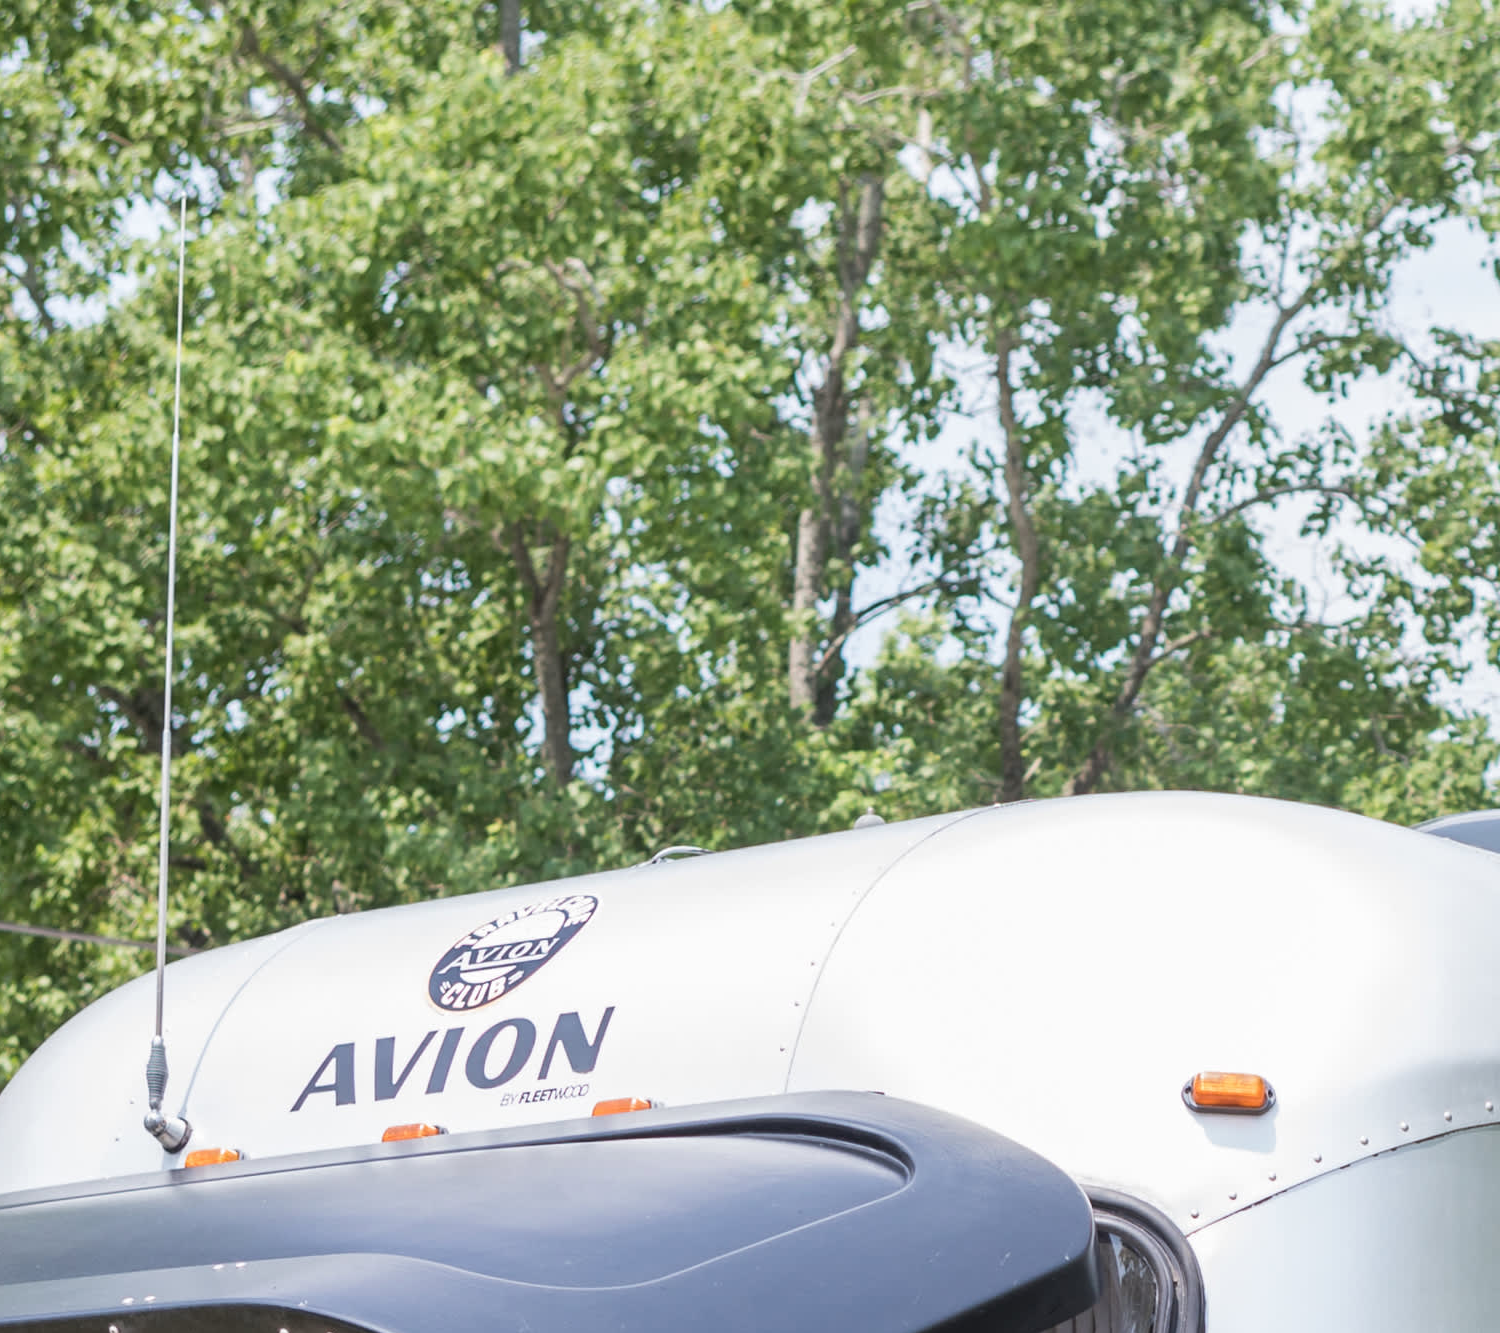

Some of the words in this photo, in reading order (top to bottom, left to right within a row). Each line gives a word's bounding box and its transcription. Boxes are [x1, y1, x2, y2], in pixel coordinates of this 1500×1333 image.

[438, 937, 561, 975] AVION
[440, 975, 508, 1009] CLUB
[289, 1006, 616, 1112] AVION
[500, 1092, 519, 1106] BY
[519, 1083, 590, 1104] FLEETWOOD
